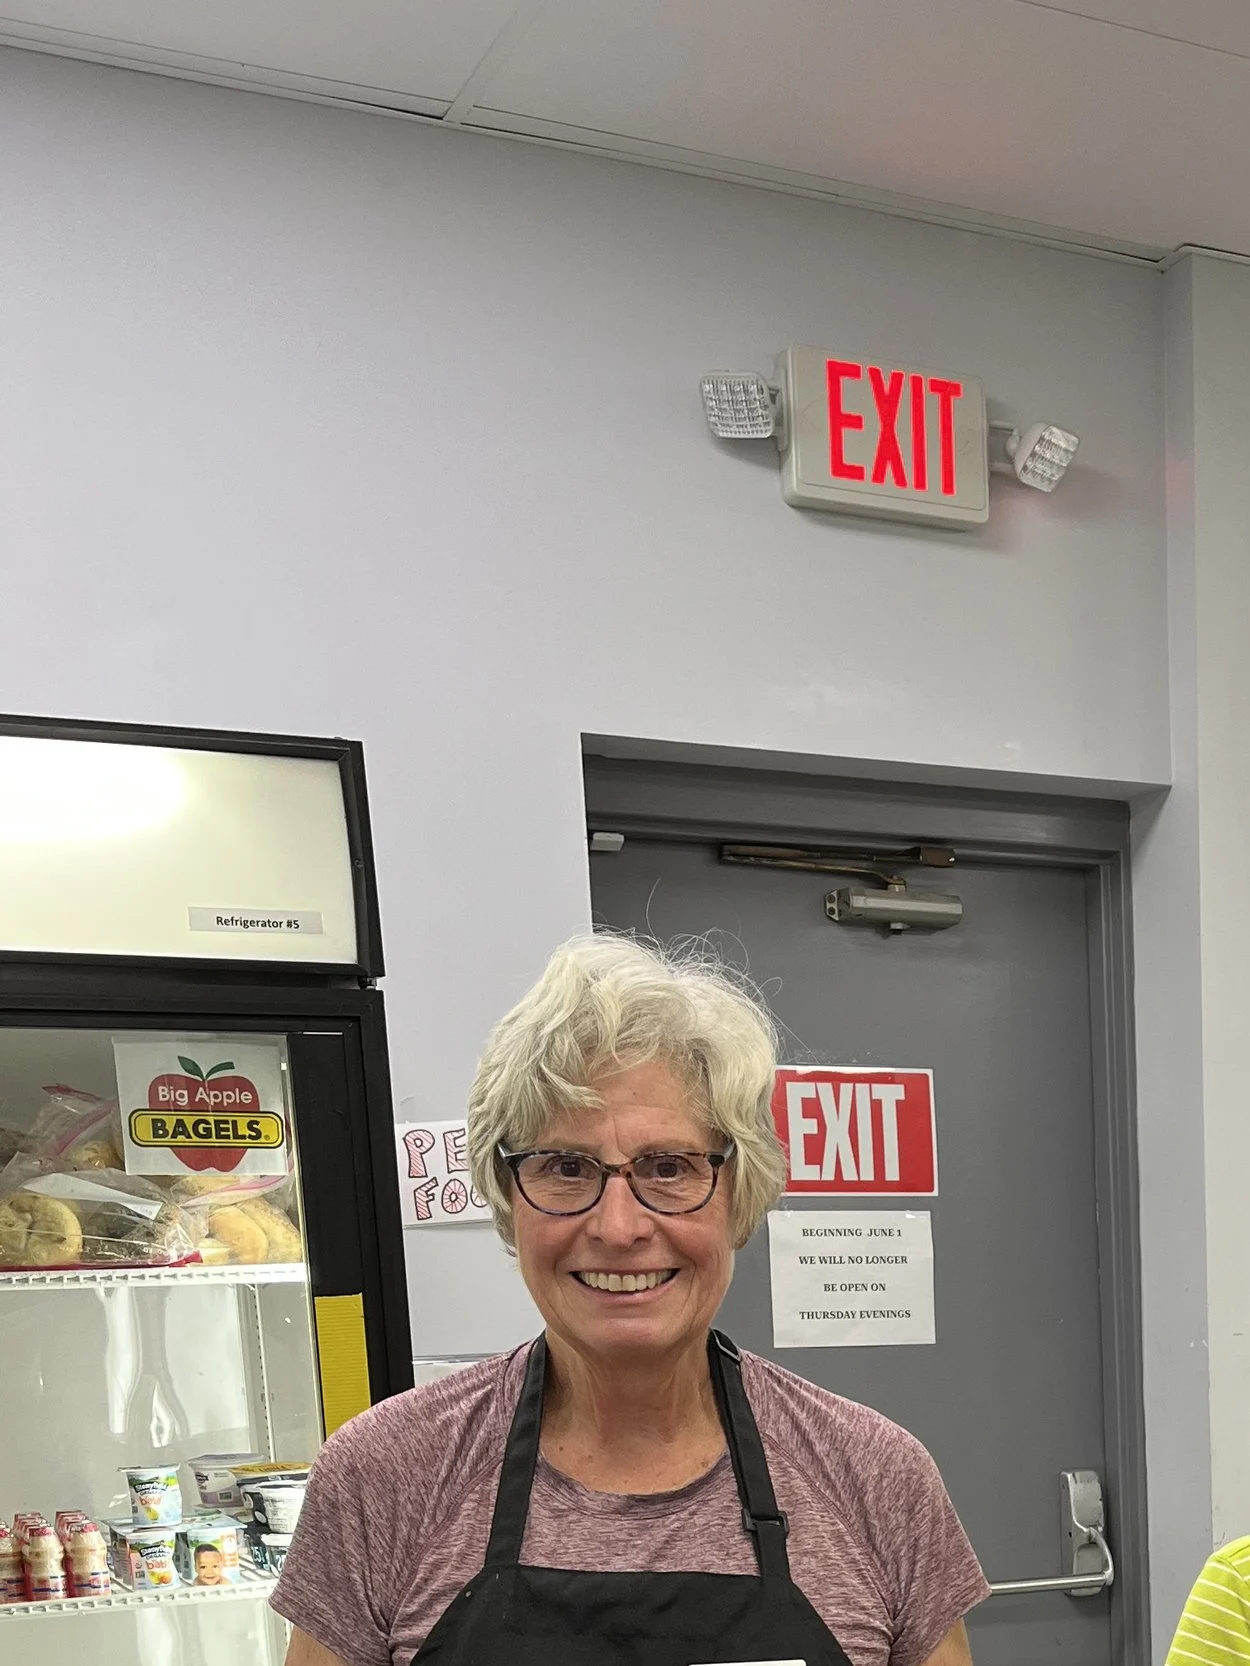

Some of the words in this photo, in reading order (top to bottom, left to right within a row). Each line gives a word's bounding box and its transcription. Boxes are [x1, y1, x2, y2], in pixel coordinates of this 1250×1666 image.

[826, 360, 963, 496] EXIT
[215, 914, 285, 930] Refrigerator
[286, 917, 300, 930] #5
[158, 1086, 188, 1105] Big
[195, 1087, 253, 1106] Apple
[151, 1118, 262, 1141] BAGELS
[785, 1081, 905, 1182] EXIT
[802, 1228, 862, 1237] BEGINNING
[867, 1228, 895, 1237] JUNE
[897, 1229, 902, 1237] 1
[799, 1256, 816, 1264] WE
[818, 1256, 846, 1264] WILL
[847, 1256, 863, 1264] NO
[865, 1256, 908, 1264] LONGER
[823, 1283, 838, 1292] BE
[840, 1283, 868, 1292] OPEN
[870, 1283, 886, 1292] ON
[799, 1311, 857, 1319] THURSDAY
[859, 1310, 911, 1319] EVENINGS
